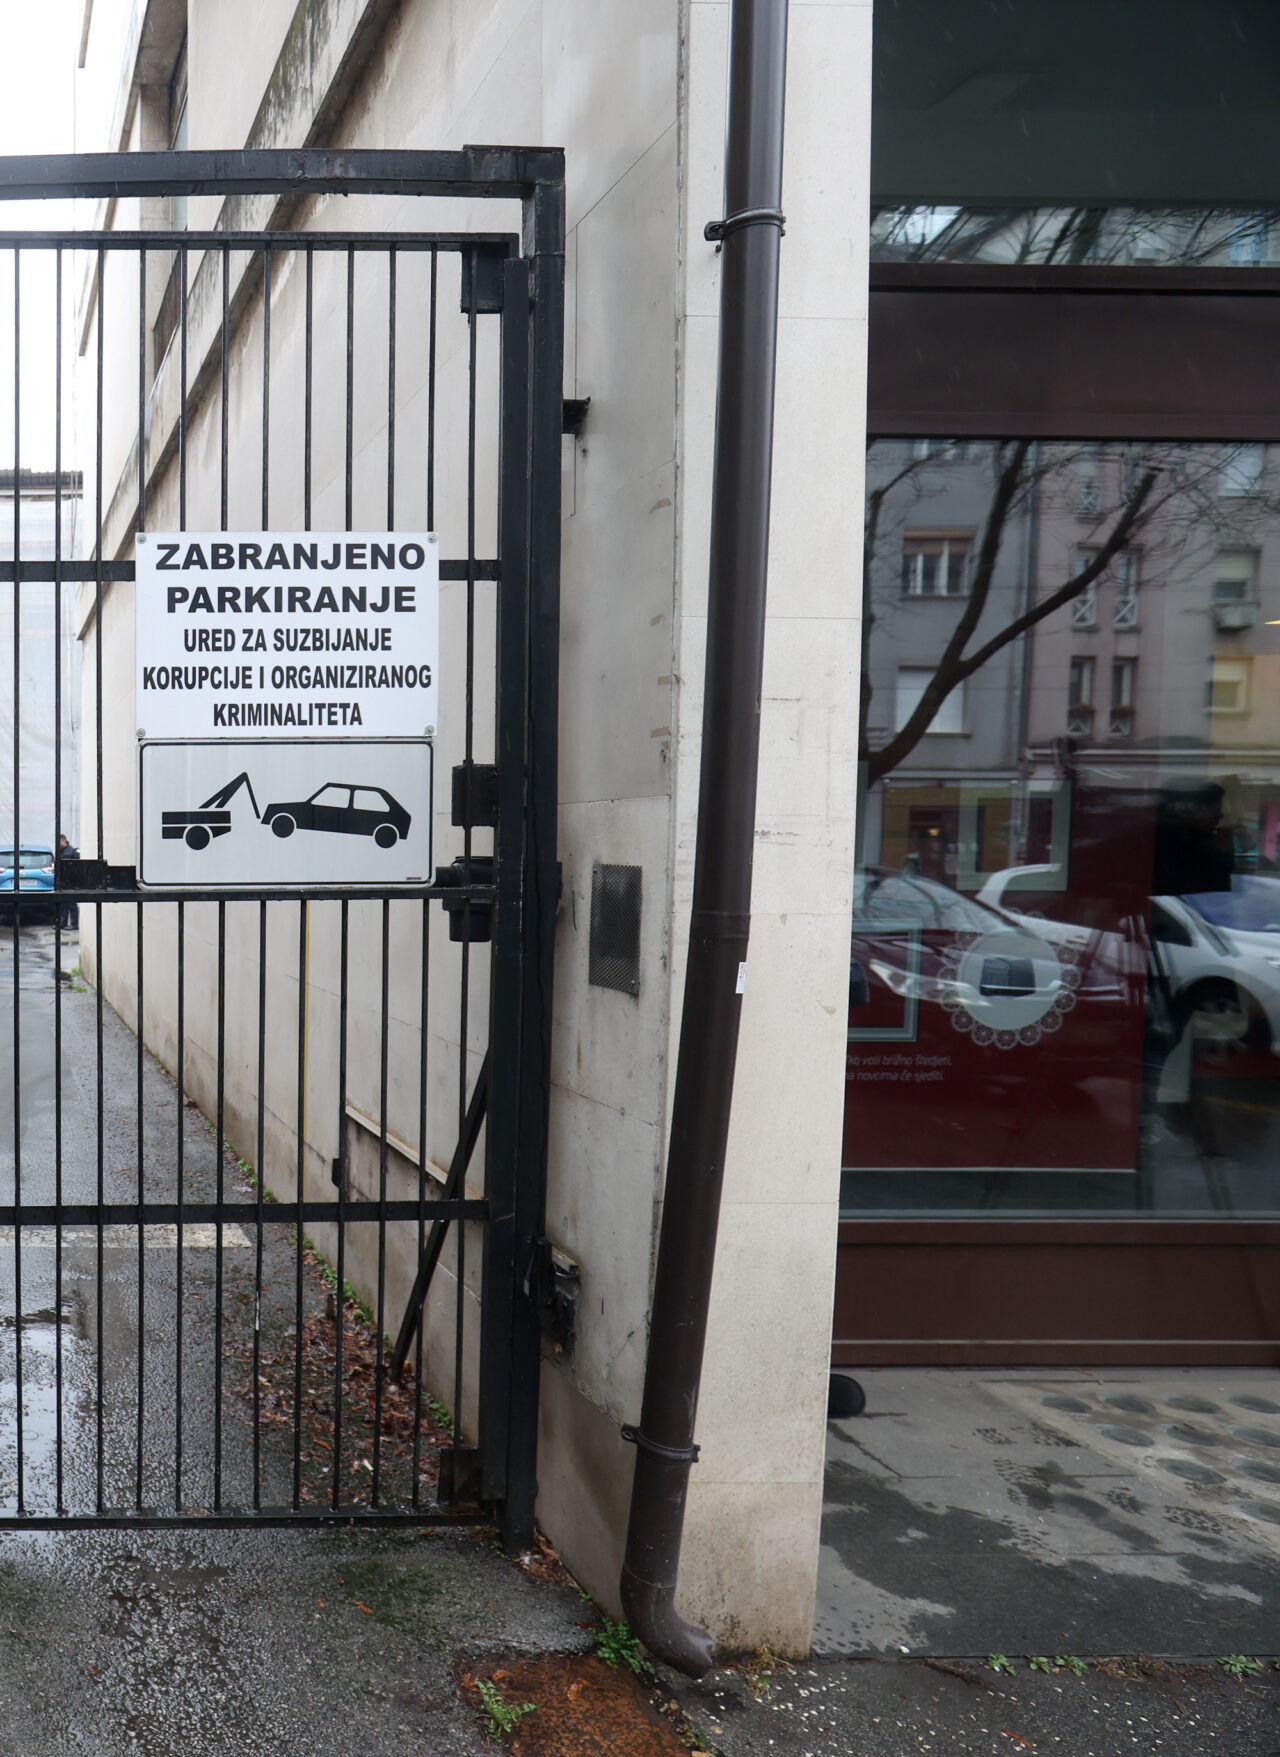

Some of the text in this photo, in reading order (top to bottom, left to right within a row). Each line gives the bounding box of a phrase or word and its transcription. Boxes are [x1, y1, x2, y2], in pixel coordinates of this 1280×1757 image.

[156, 543, 425, 570] ZABRANJENO
[168, 587, 415, 613] PARKIRANJE
[185, 628, 391, 652] URED ZA SUZBIJANJE
[144, 665, 431, 689] KORUPCIJE I ORGANIZIRANOG
[214, 703, 362, 726] KRIMINALITETA
